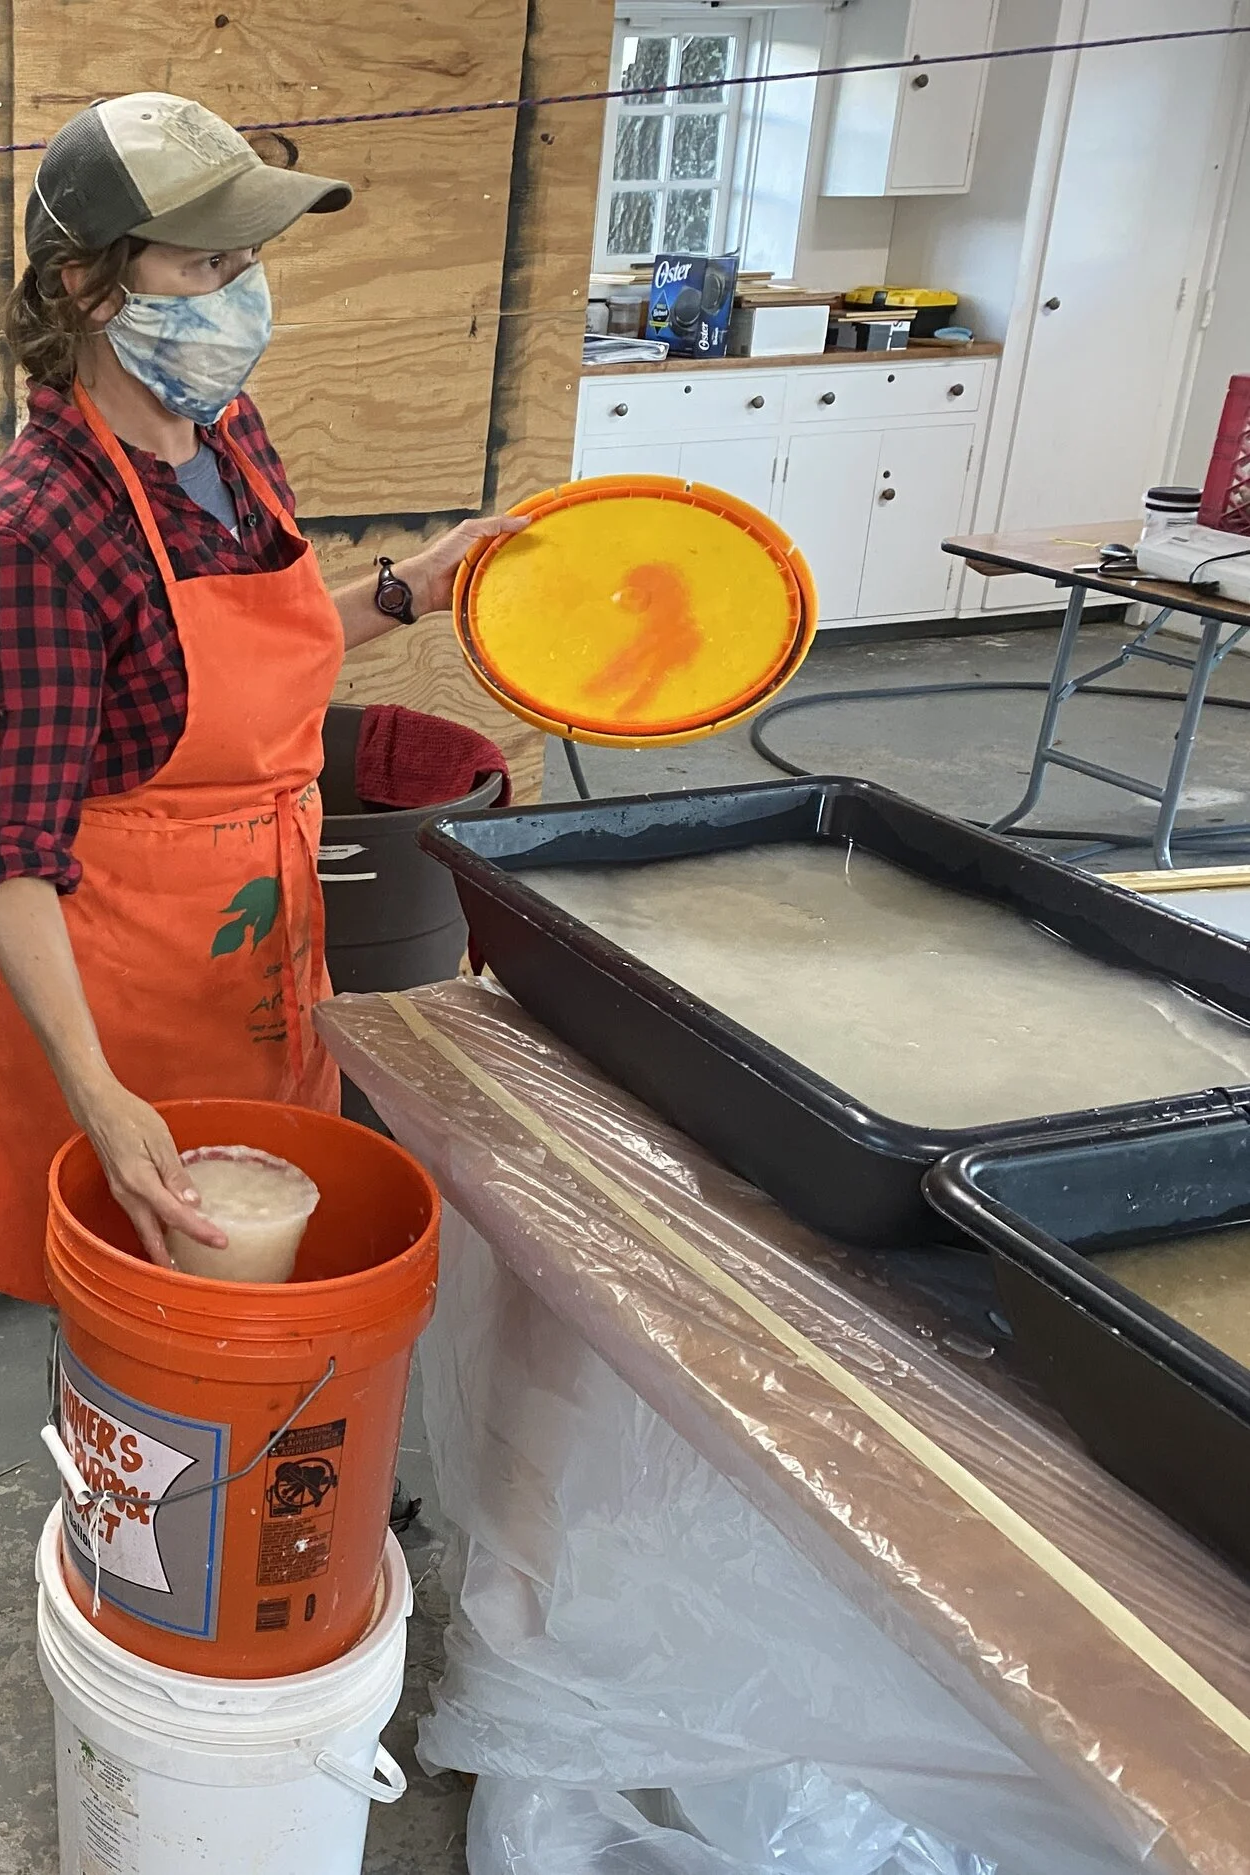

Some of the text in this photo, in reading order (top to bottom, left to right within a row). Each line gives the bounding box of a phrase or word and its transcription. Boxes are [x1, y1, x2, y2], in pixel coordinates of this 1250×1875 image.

[655, 261, 692, 288] Oster
[699, 321, 709, 350] Oster
[61, 1370, 143, 1473] HOMER'S
